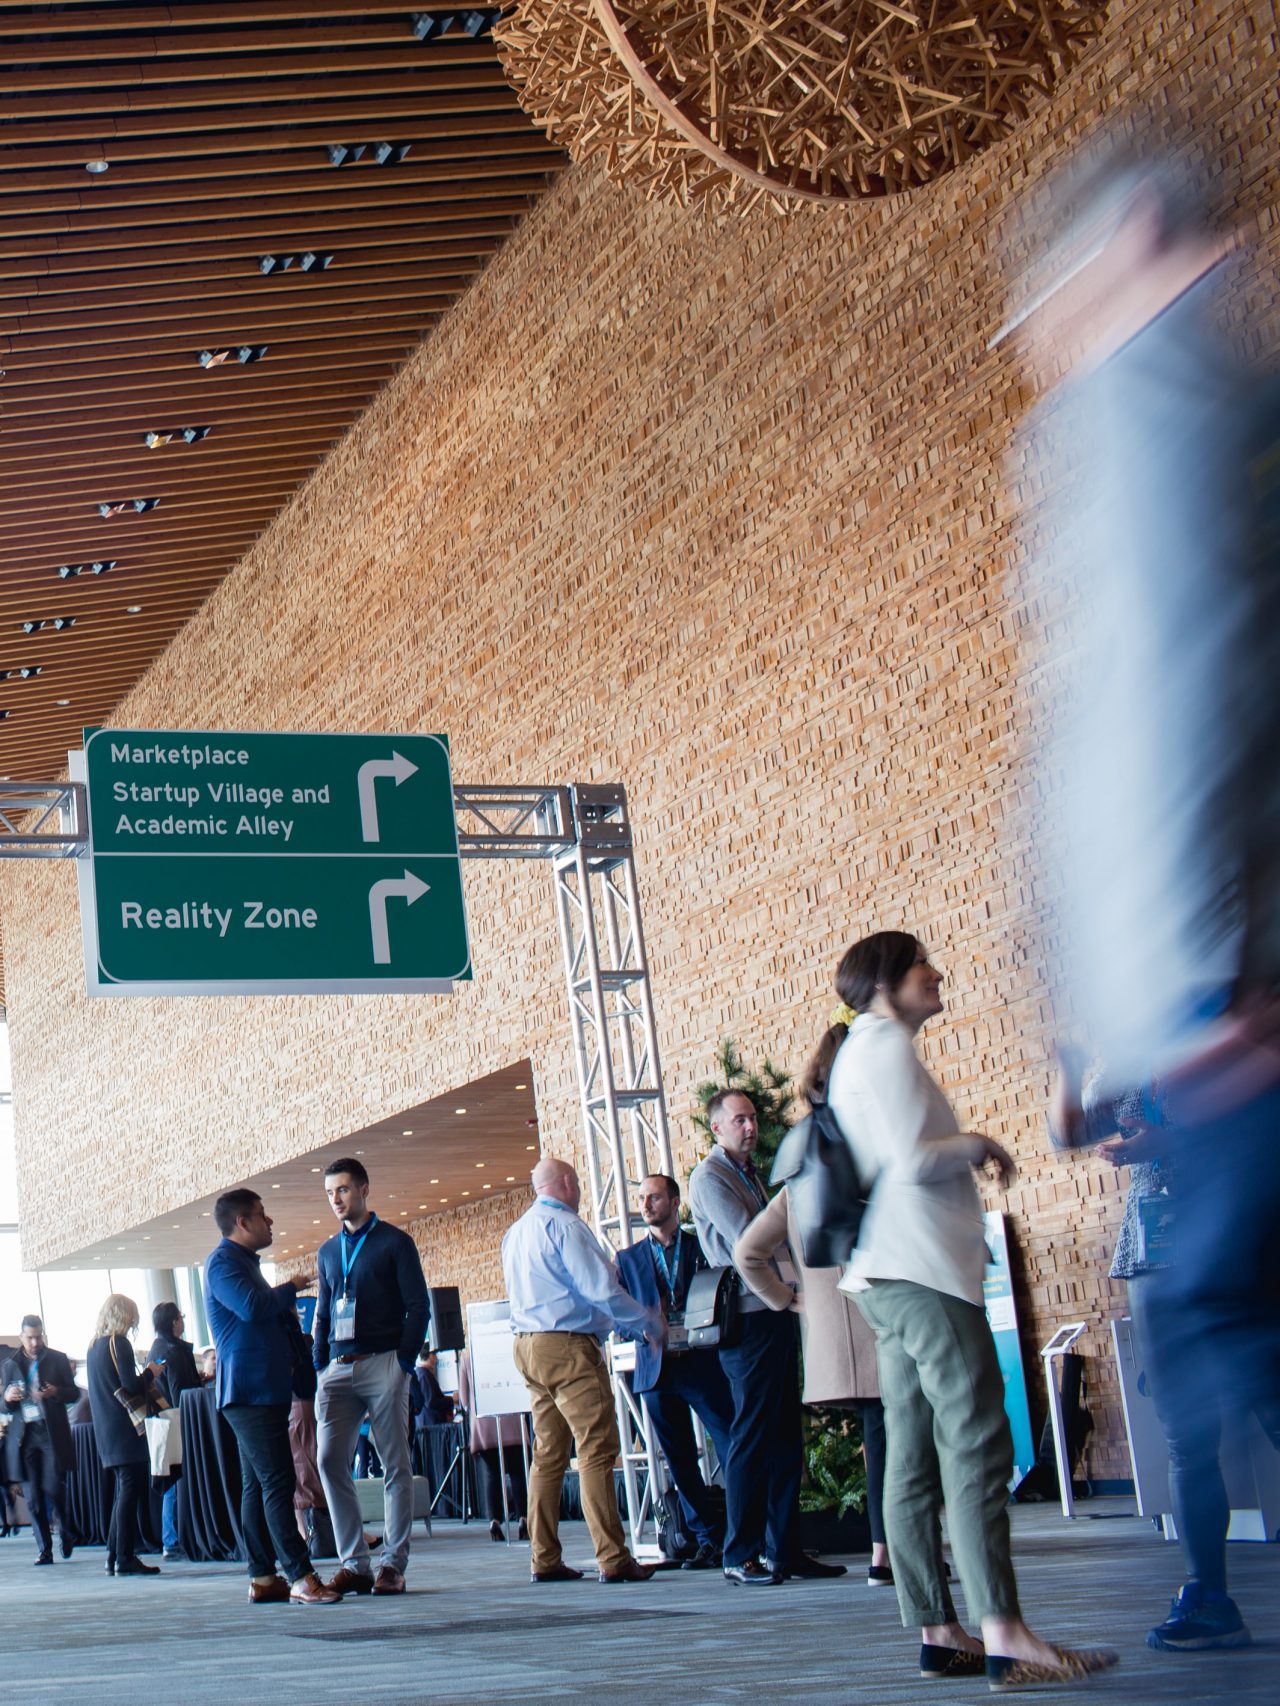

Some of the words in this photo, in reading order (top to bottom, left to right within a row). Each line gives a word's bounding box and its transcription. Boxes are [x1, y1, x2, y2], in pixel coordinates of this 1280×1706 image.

[111, 744, 248, 769] Marketplace
[114, 782, 199, 807] Startup
[208, 784, 283, 808] Village
[292, 785, 329, 803] and
[116, 815, 227, 834] Academic
[236, 816, 293, 841] Alley
[122, 902, 232, 937] Reality
[244, 902, 317, 928] Zone
